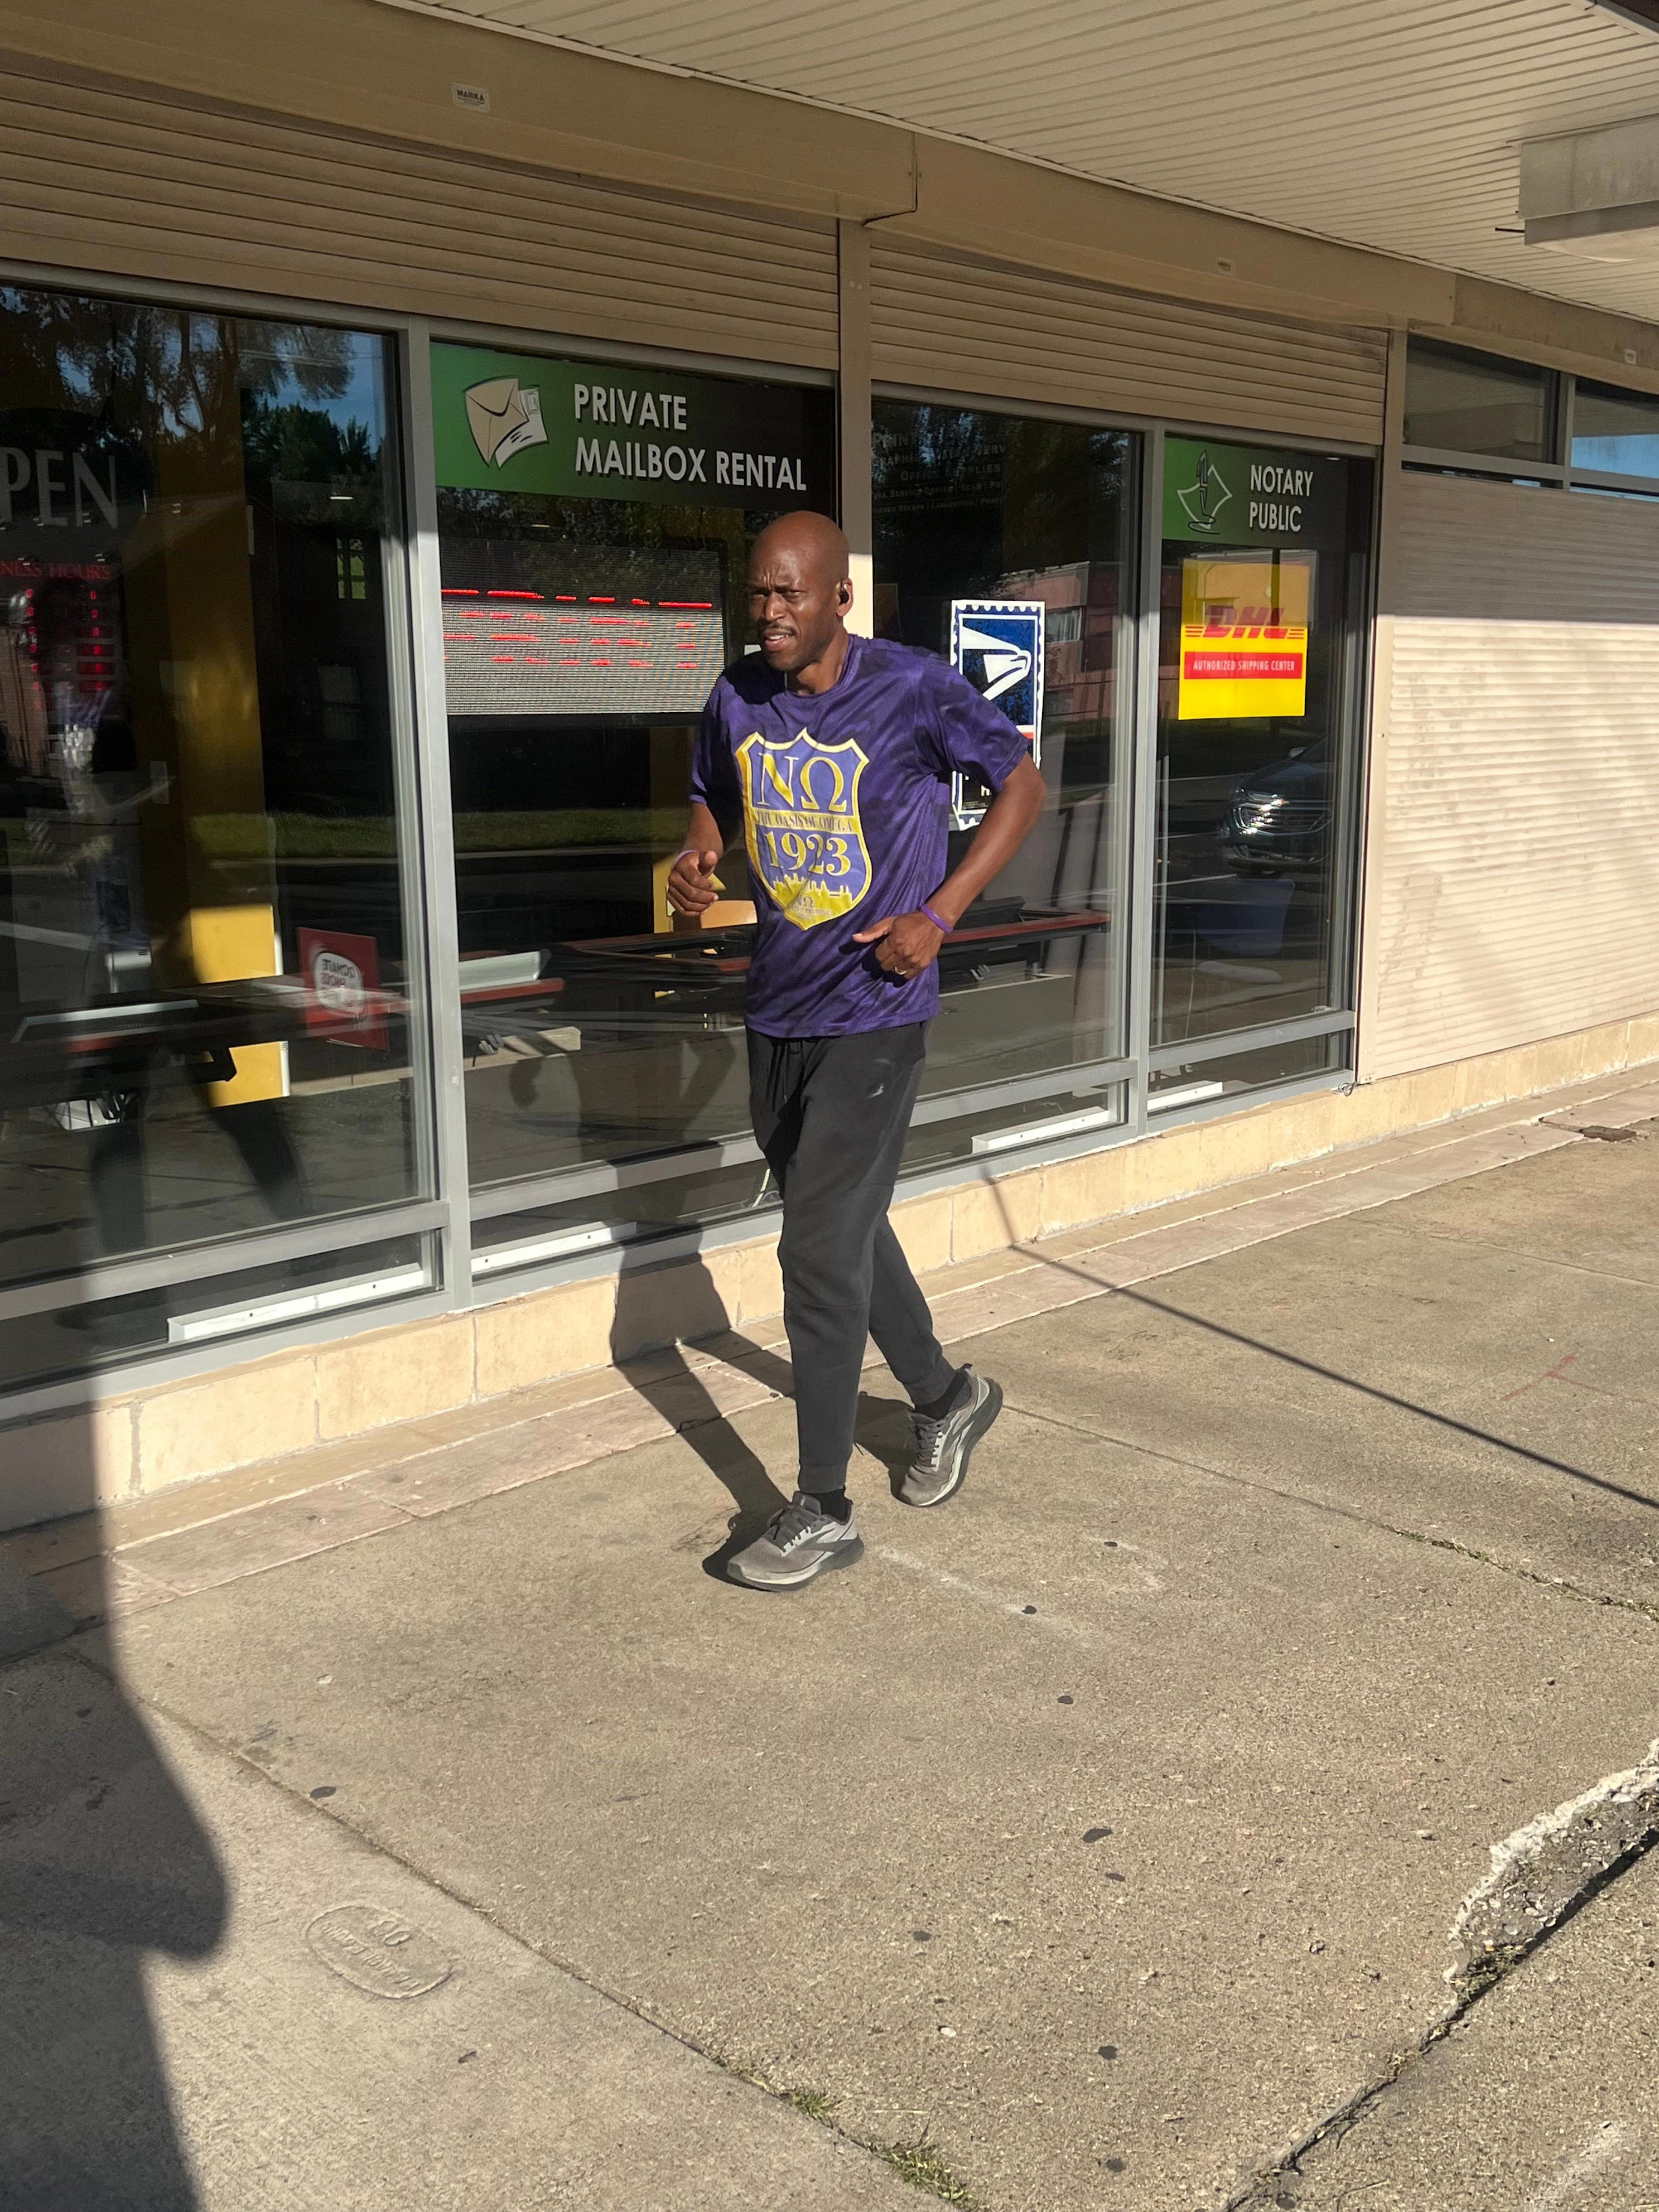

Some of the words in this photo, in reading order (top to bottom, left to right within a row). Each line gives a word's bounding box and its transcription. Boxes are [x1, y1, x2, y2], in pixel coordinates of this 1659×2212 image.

[456, 89, 485, 102] MARKA
[574, 383, 687, 431] PRIVATE
[575, 437, 707, 483] MAILBOX
[716, 450, 807, 491] RENTAL
[1251, 464, 1314, 497] NOTARY
[1249, 501, 1303, 532] PUBLIC
[1203, 605, 1289, 639] DHL
[1193, 660, 1236, 670] AUTHORIZED
[1238, 660, 1269, 671] SHIPPING
[1271, 660, 1295, 671] CENTER
[764, 830, 851, 876] 1923
